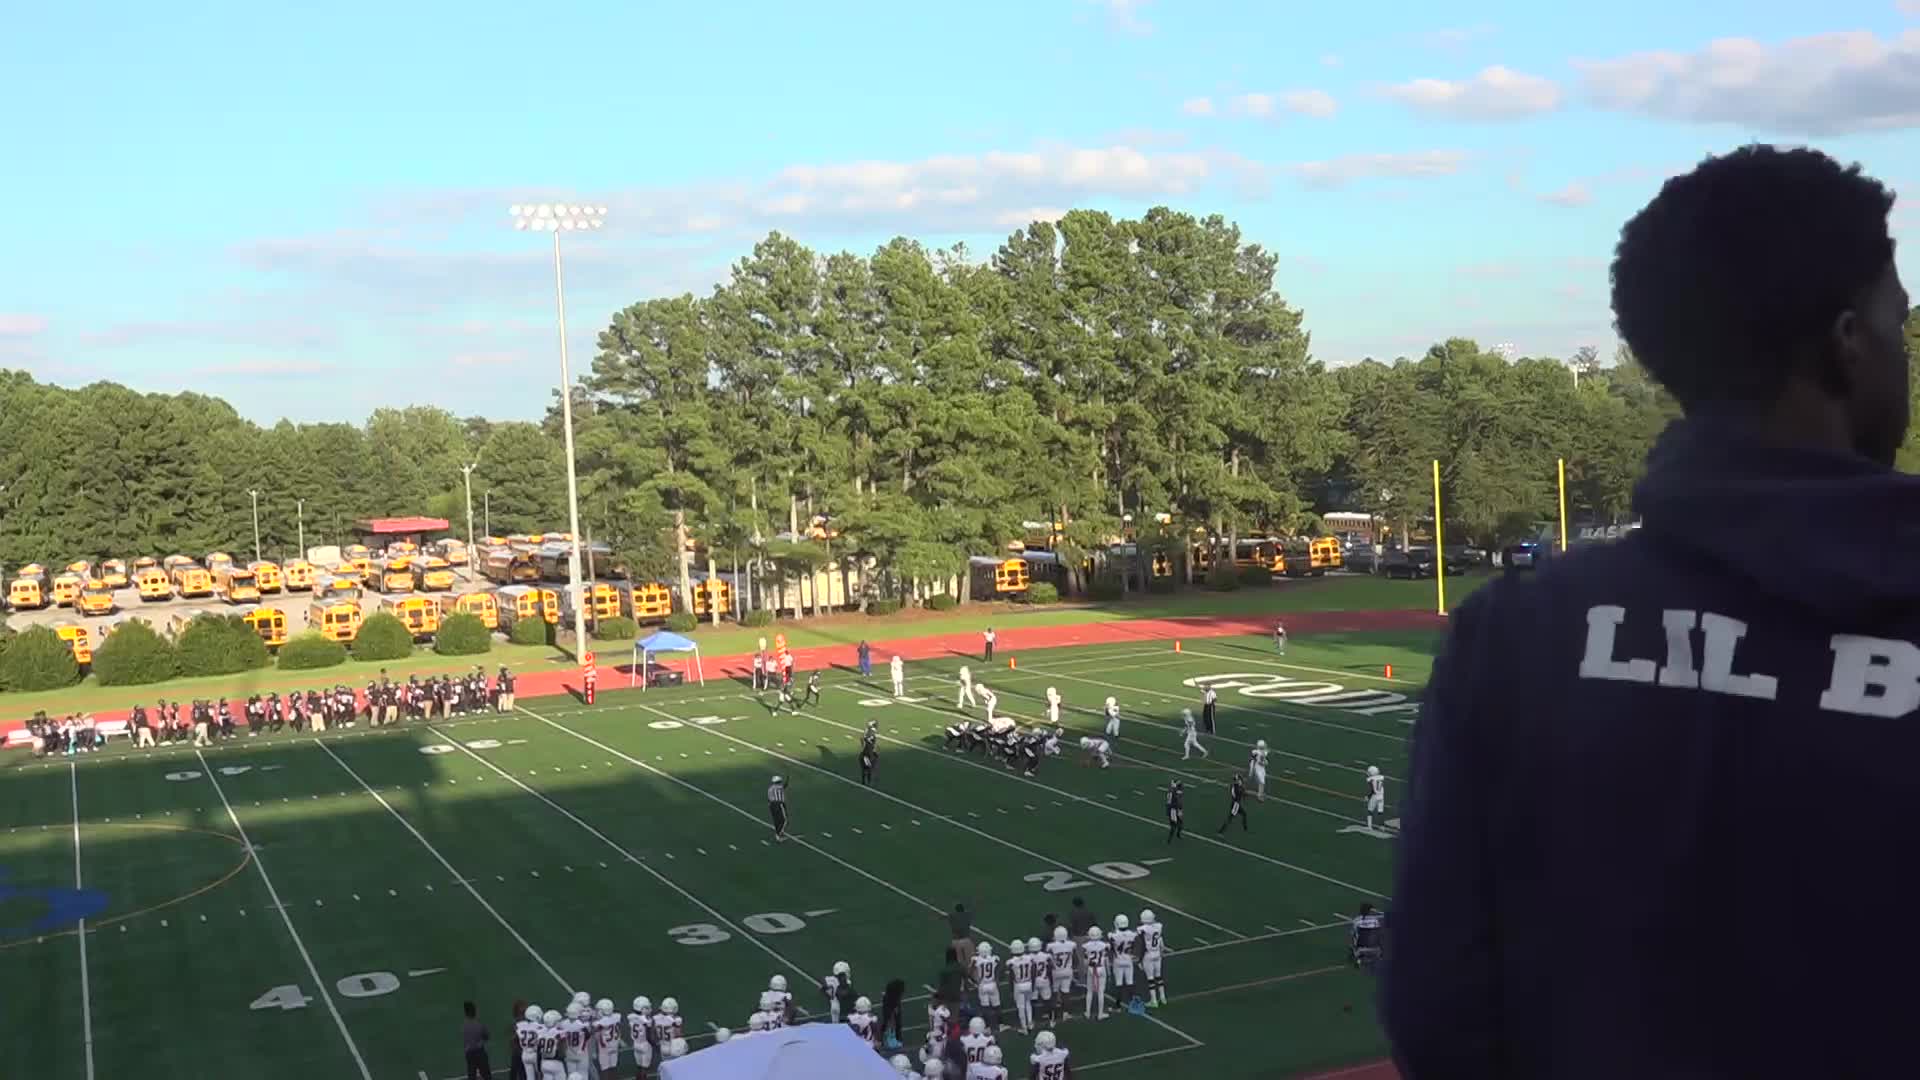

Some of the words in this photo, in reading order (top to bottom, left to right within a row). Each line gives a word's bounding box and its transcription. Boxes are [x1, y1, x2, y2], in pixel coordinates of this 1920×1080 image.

[1579, 605, 1778, 700] LIL
[1023, 861, 1151, 892] 20
[667, 912, 807, 945] 30
[249, 971, 401, 1010] 40
